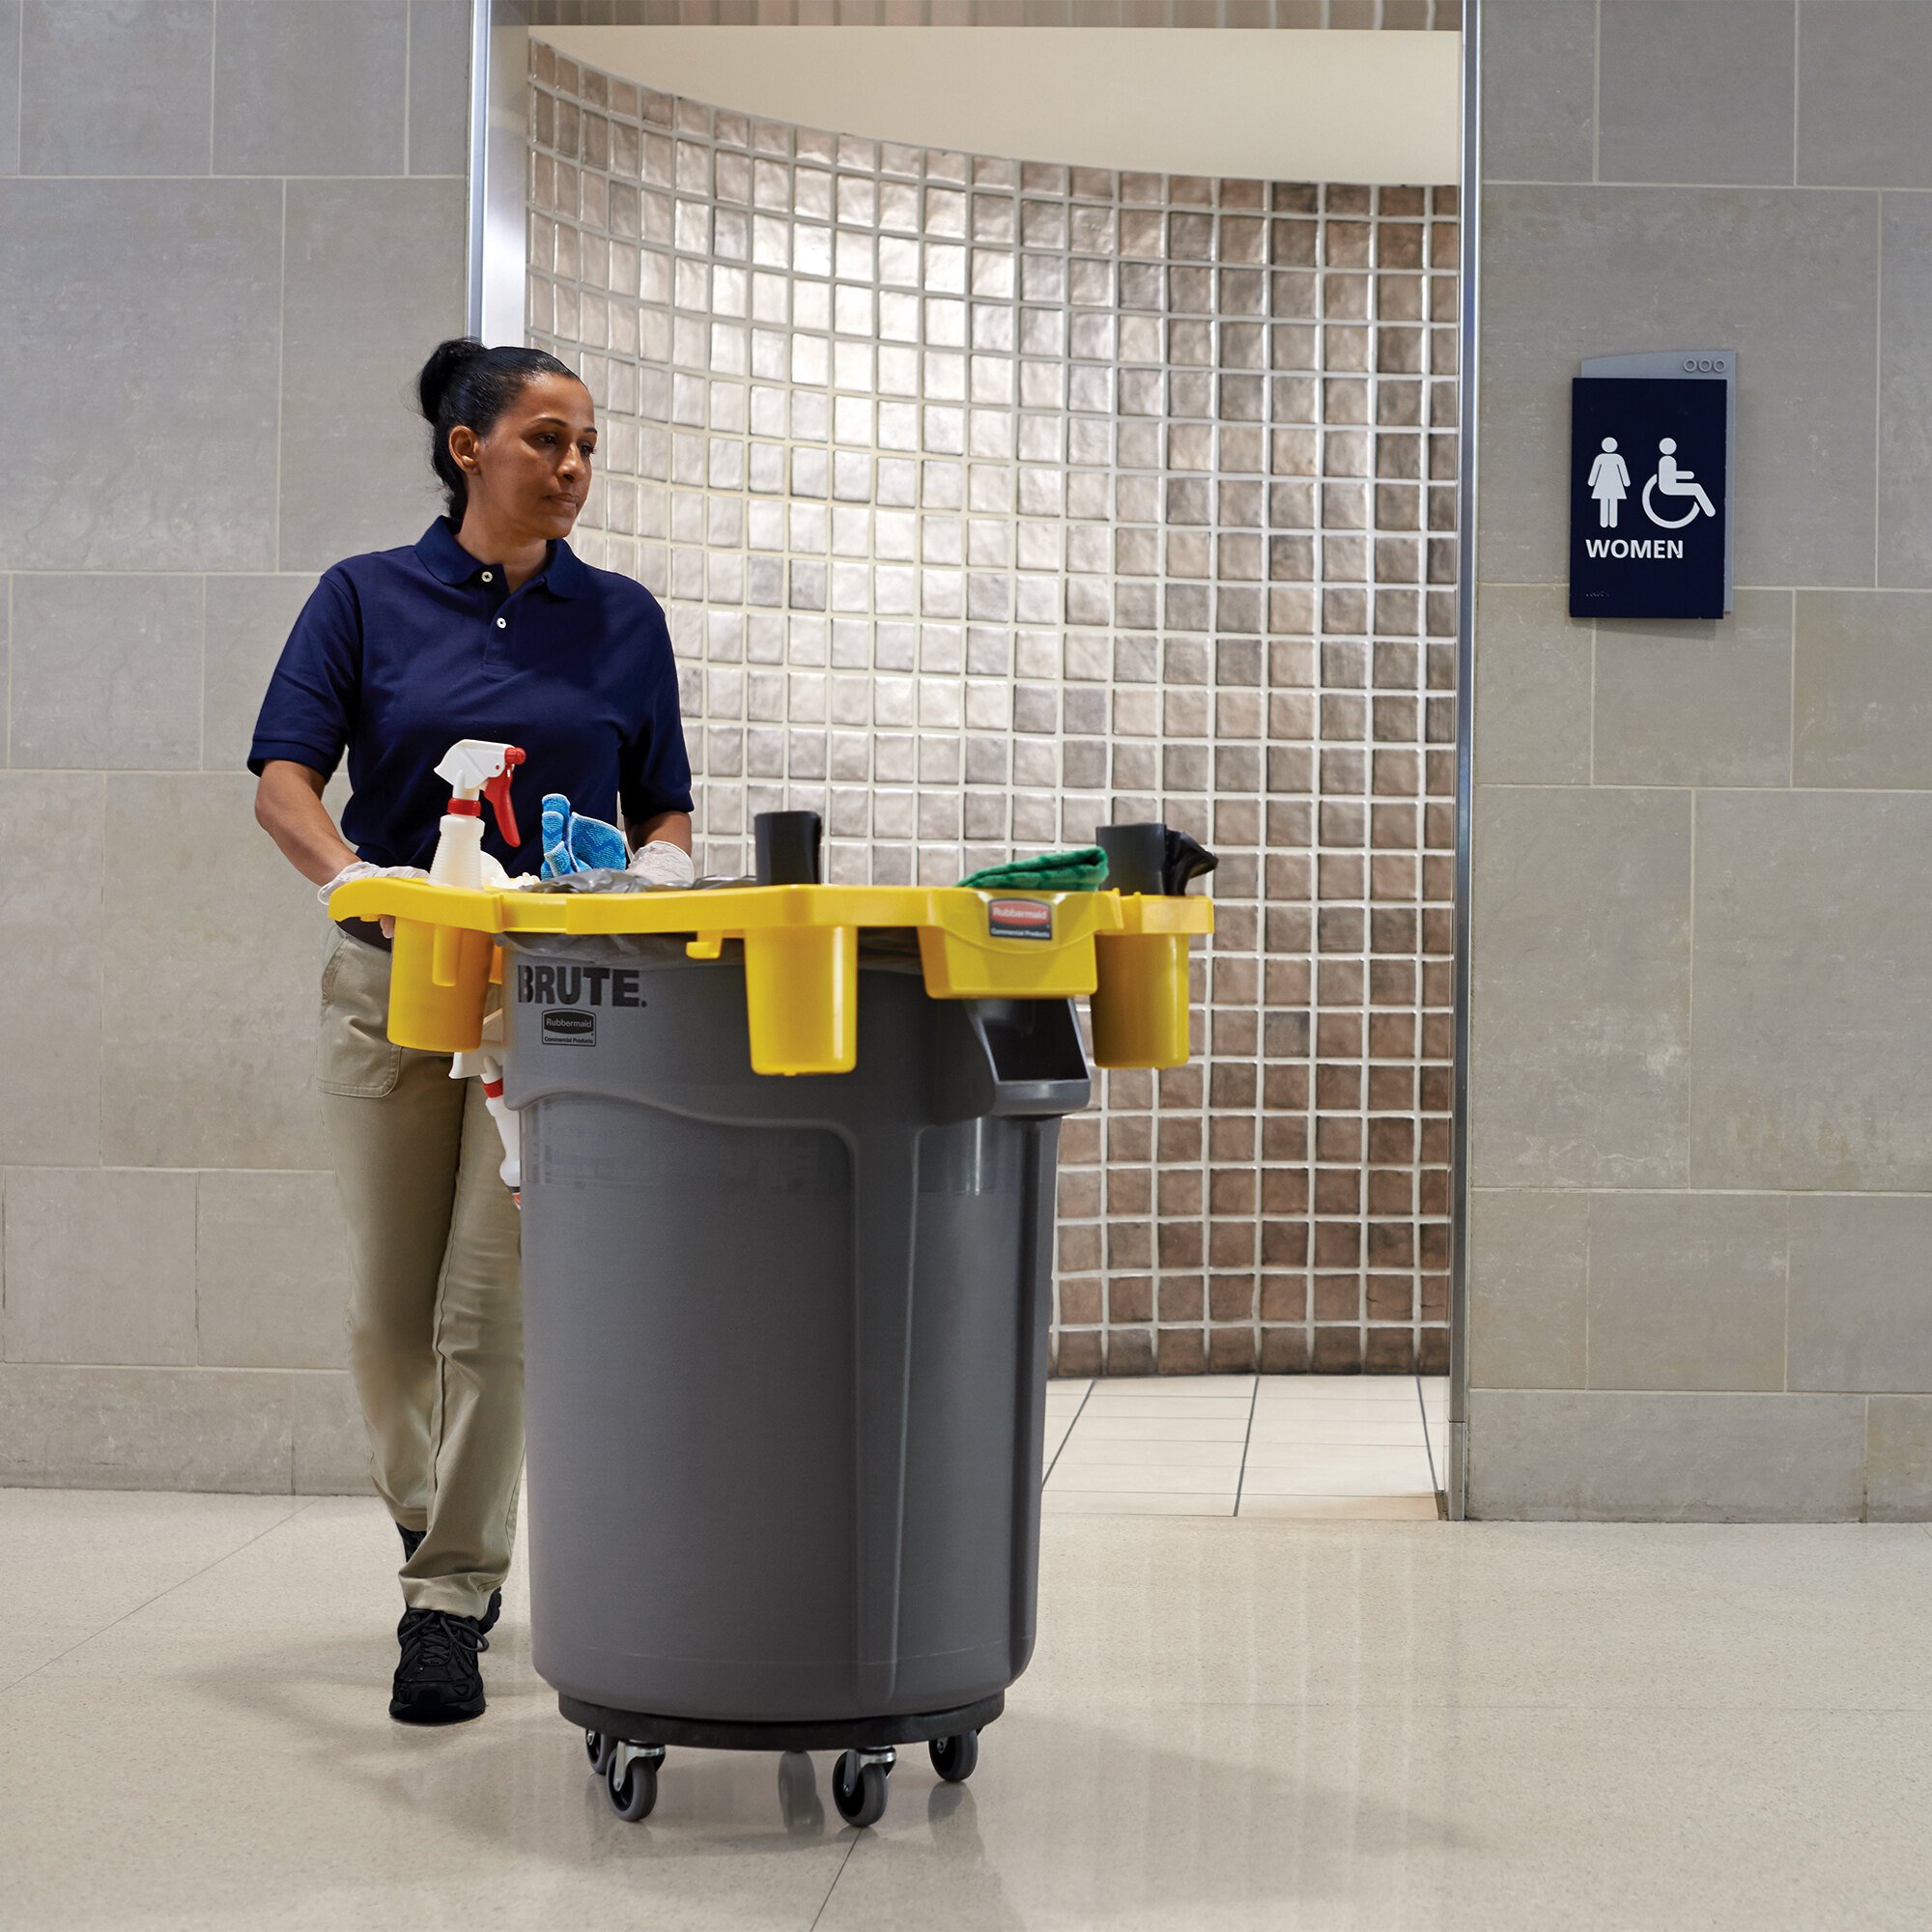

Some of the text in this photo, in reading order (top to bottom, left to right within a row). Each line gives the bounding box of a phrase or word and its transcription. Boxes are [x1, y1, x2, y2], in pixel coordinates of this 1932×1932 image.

[1585, 539, 1684, 559] WOMEN
[992, 906, 1047, 920] Rubbermaid
[546, 1018, 592, 1028] Rubbermaid
